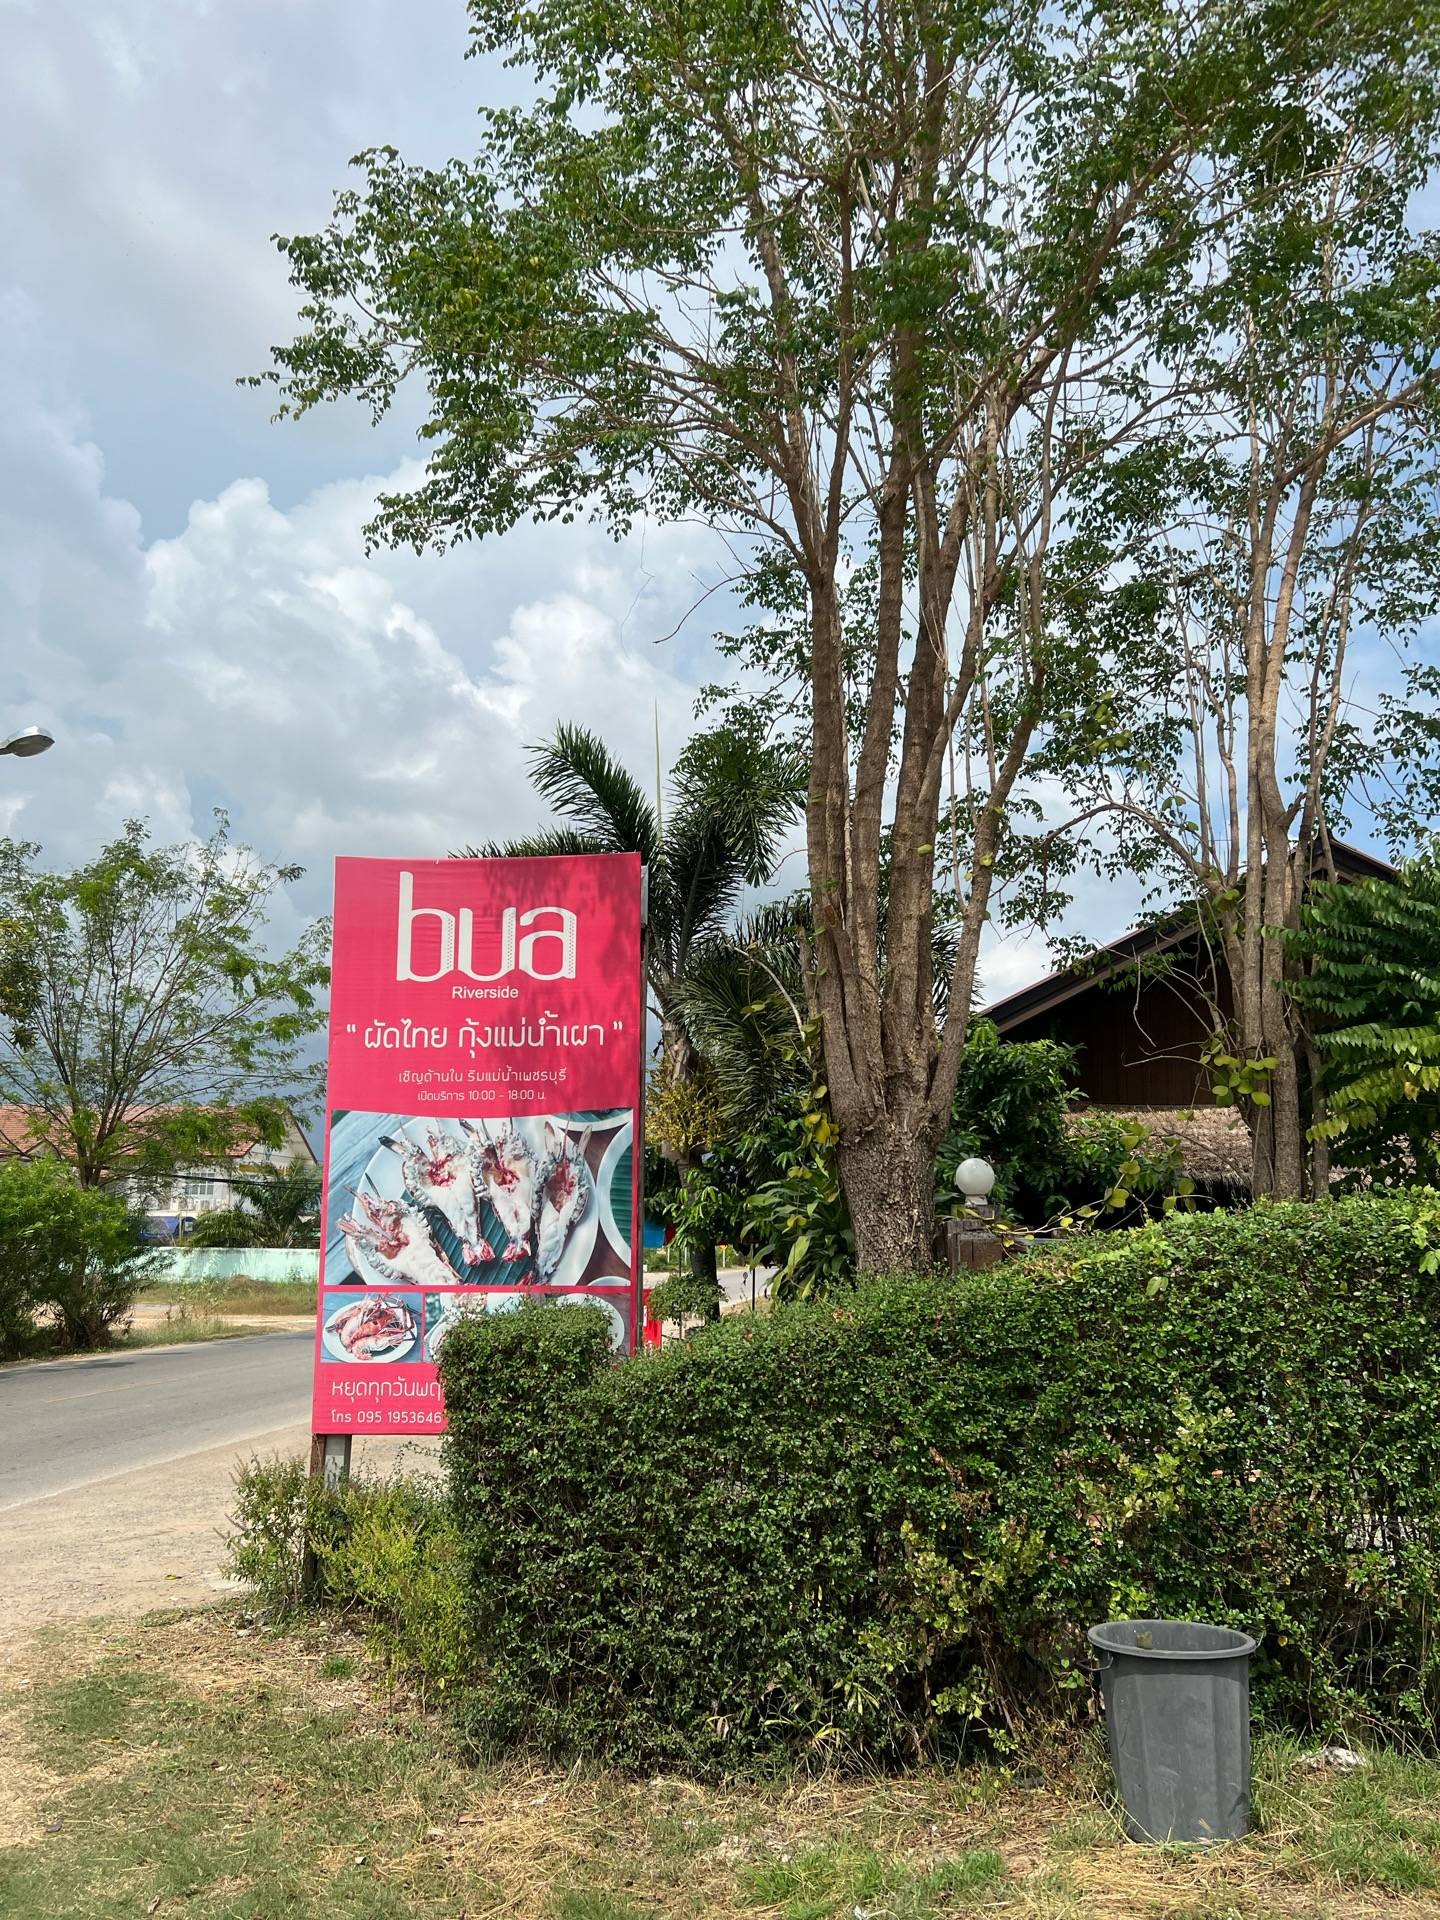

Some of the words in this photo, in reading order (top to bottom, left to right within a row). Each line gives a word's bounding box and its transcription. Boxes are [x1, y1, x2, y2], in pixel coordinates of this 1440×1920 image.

[396, 871, 577, 982] bua
[452, 986, 519, 999] Riverside
[364, 1018, 448, 1049] ผัดไทย
[458, 1010, 604, 1059] กุ้งแม่น้ำเผา
[331, 1375, 441, 1404] หยุดทุกวันพฤ
[331, 1409, 352, 1423] โทร
[357, 1410, 382, 1423] 095
[387, 1411, 442, 1424] 1953646
